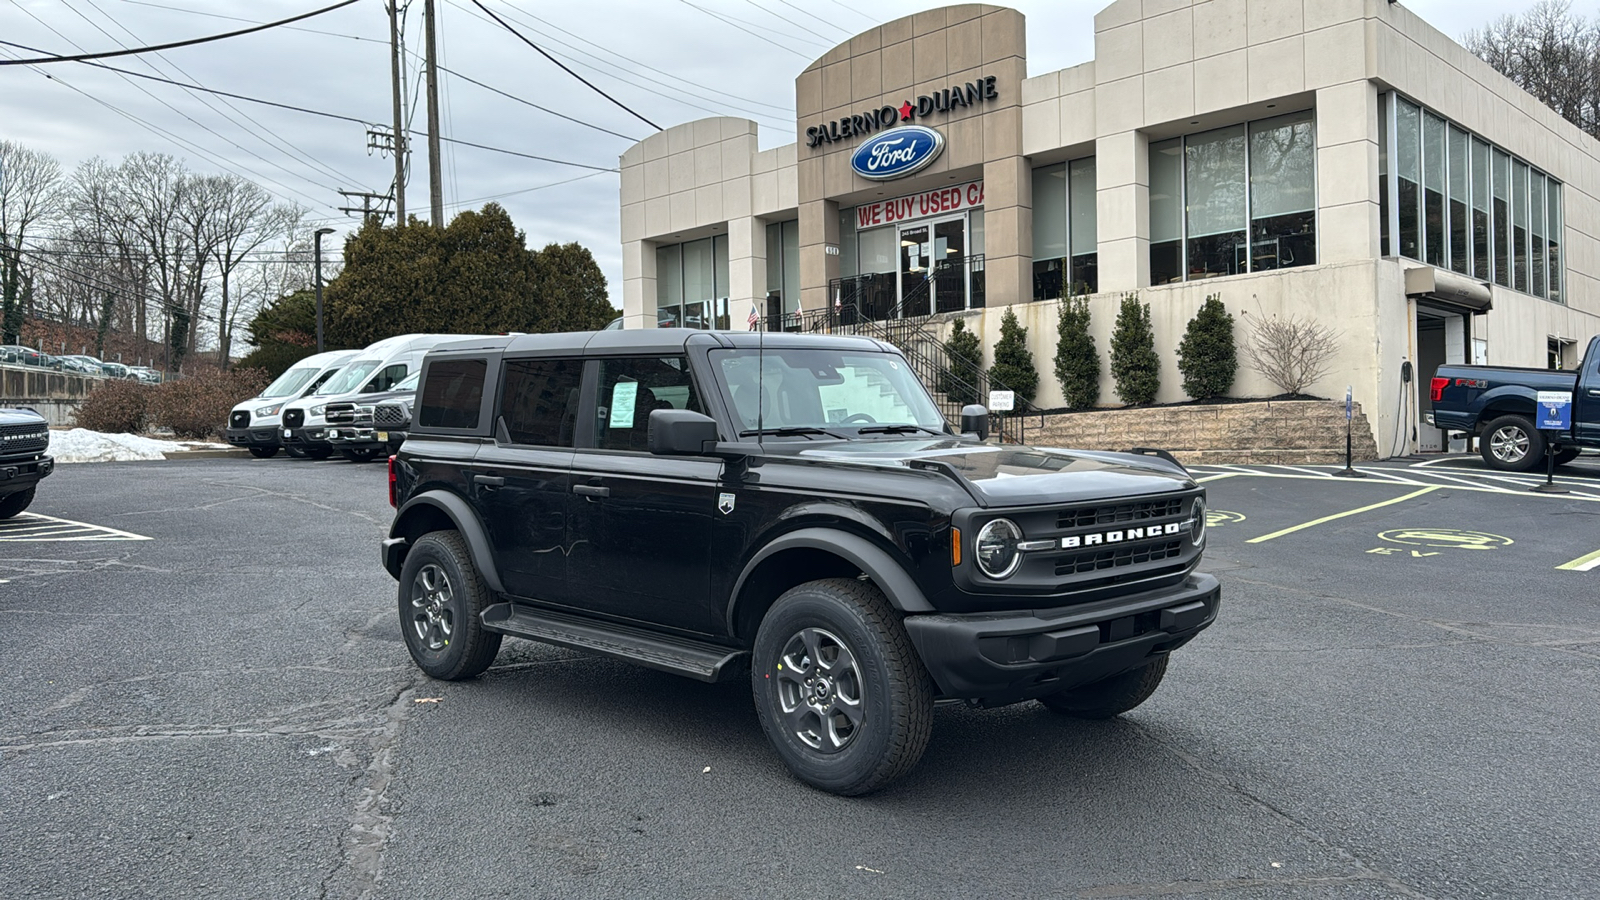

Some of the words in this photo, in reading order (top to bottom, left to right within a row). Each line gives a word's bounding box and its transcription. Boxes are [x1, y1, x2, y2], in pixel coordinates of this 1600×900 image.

[806, 104, 898, 148] SALERNO
[916, 75, 998, 118] DUANE
[867, 137, 917, 171] Ford
[858, 204, 881, 227] WE
[885, 196, 915, 222] BUY
[919, 187, 962, 215] USED
[1455, 378, 1489, 389] FX4
[4, 433, 42, 441] BRONCO
[1061, 522, 1180, 549] BRONCO
